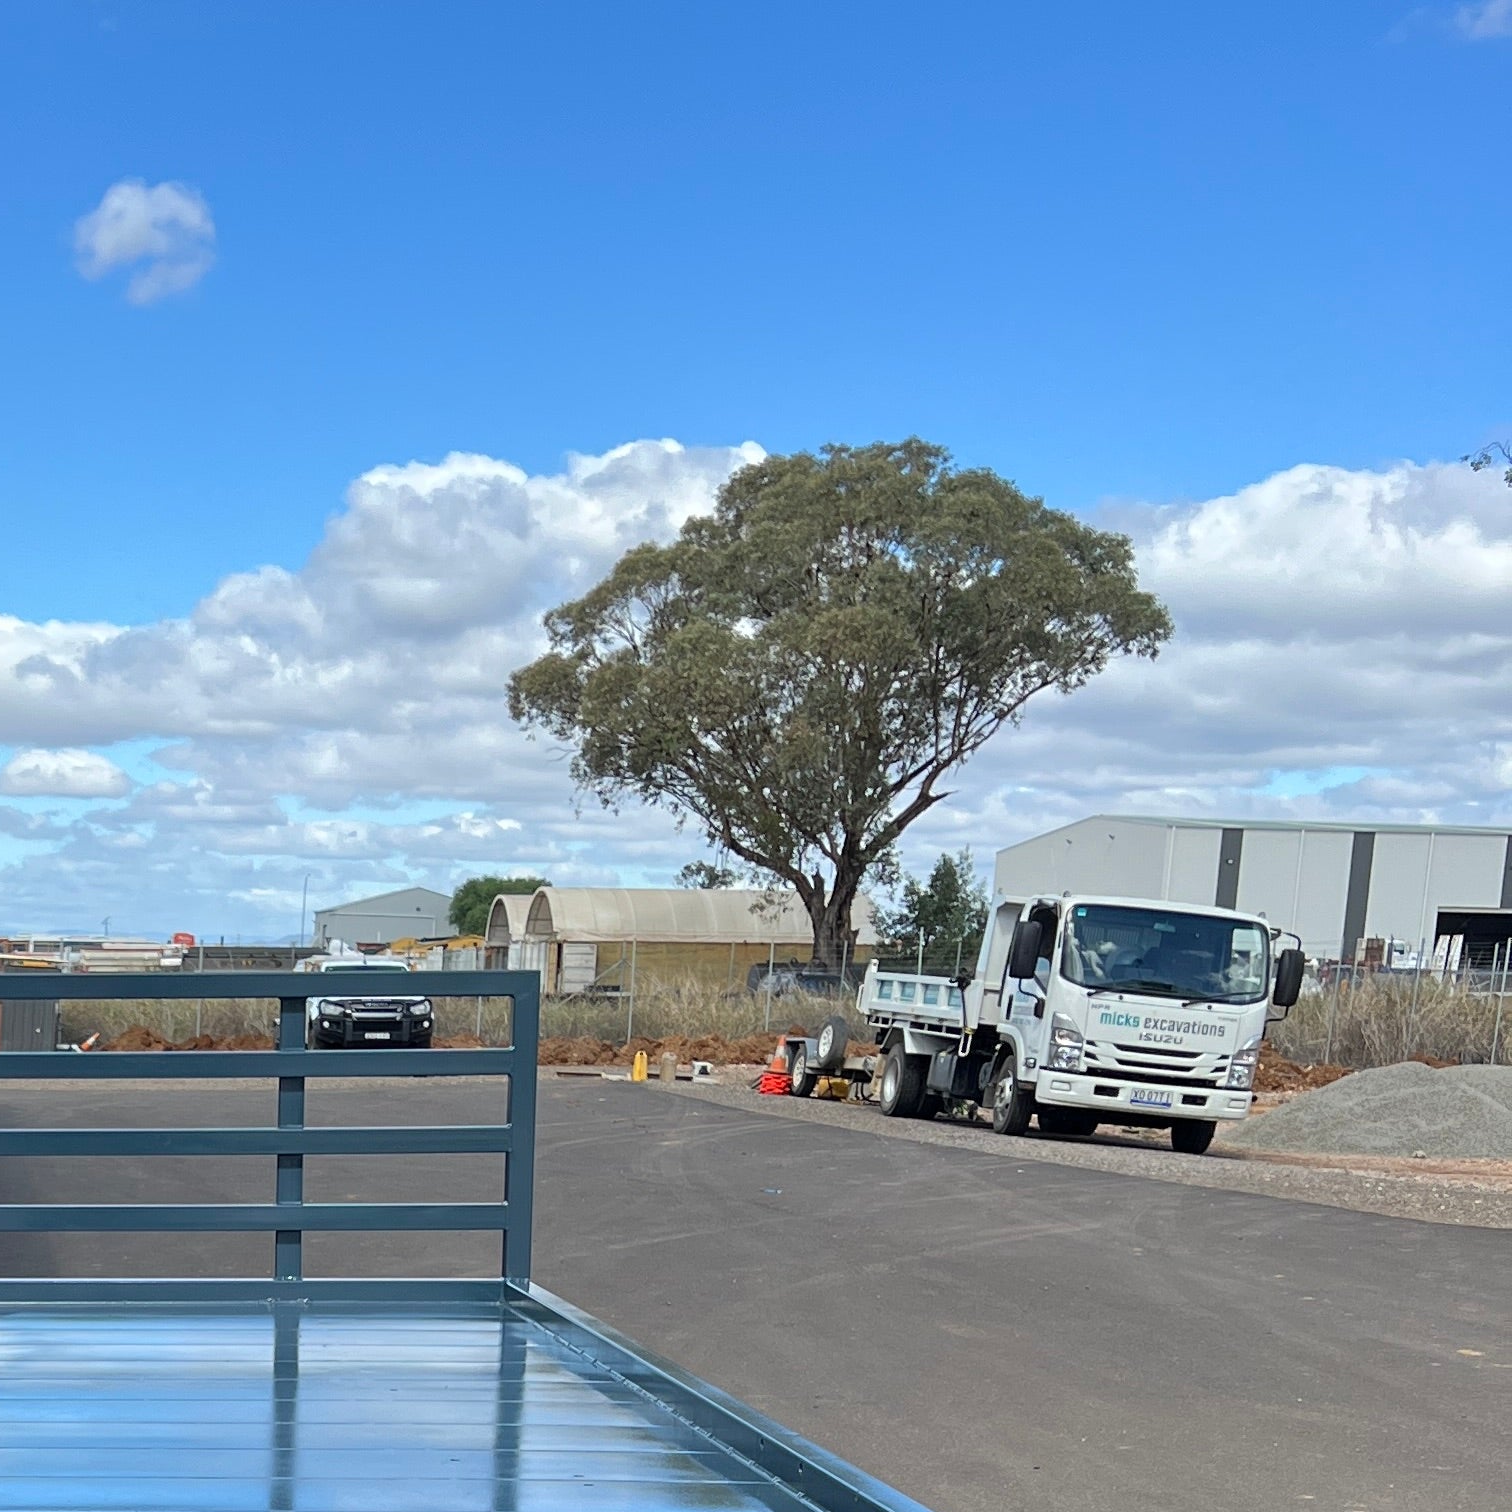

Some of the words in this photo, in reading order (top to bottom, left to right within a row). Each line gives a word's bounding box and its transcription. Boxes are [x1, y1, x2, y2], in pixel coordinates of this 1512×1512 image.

[1099, 1011, 1141, 1028] micks
[1143, 1017, 1226, 1037] excavations
[1138, 1032, 1184, 1045] ISUZU
